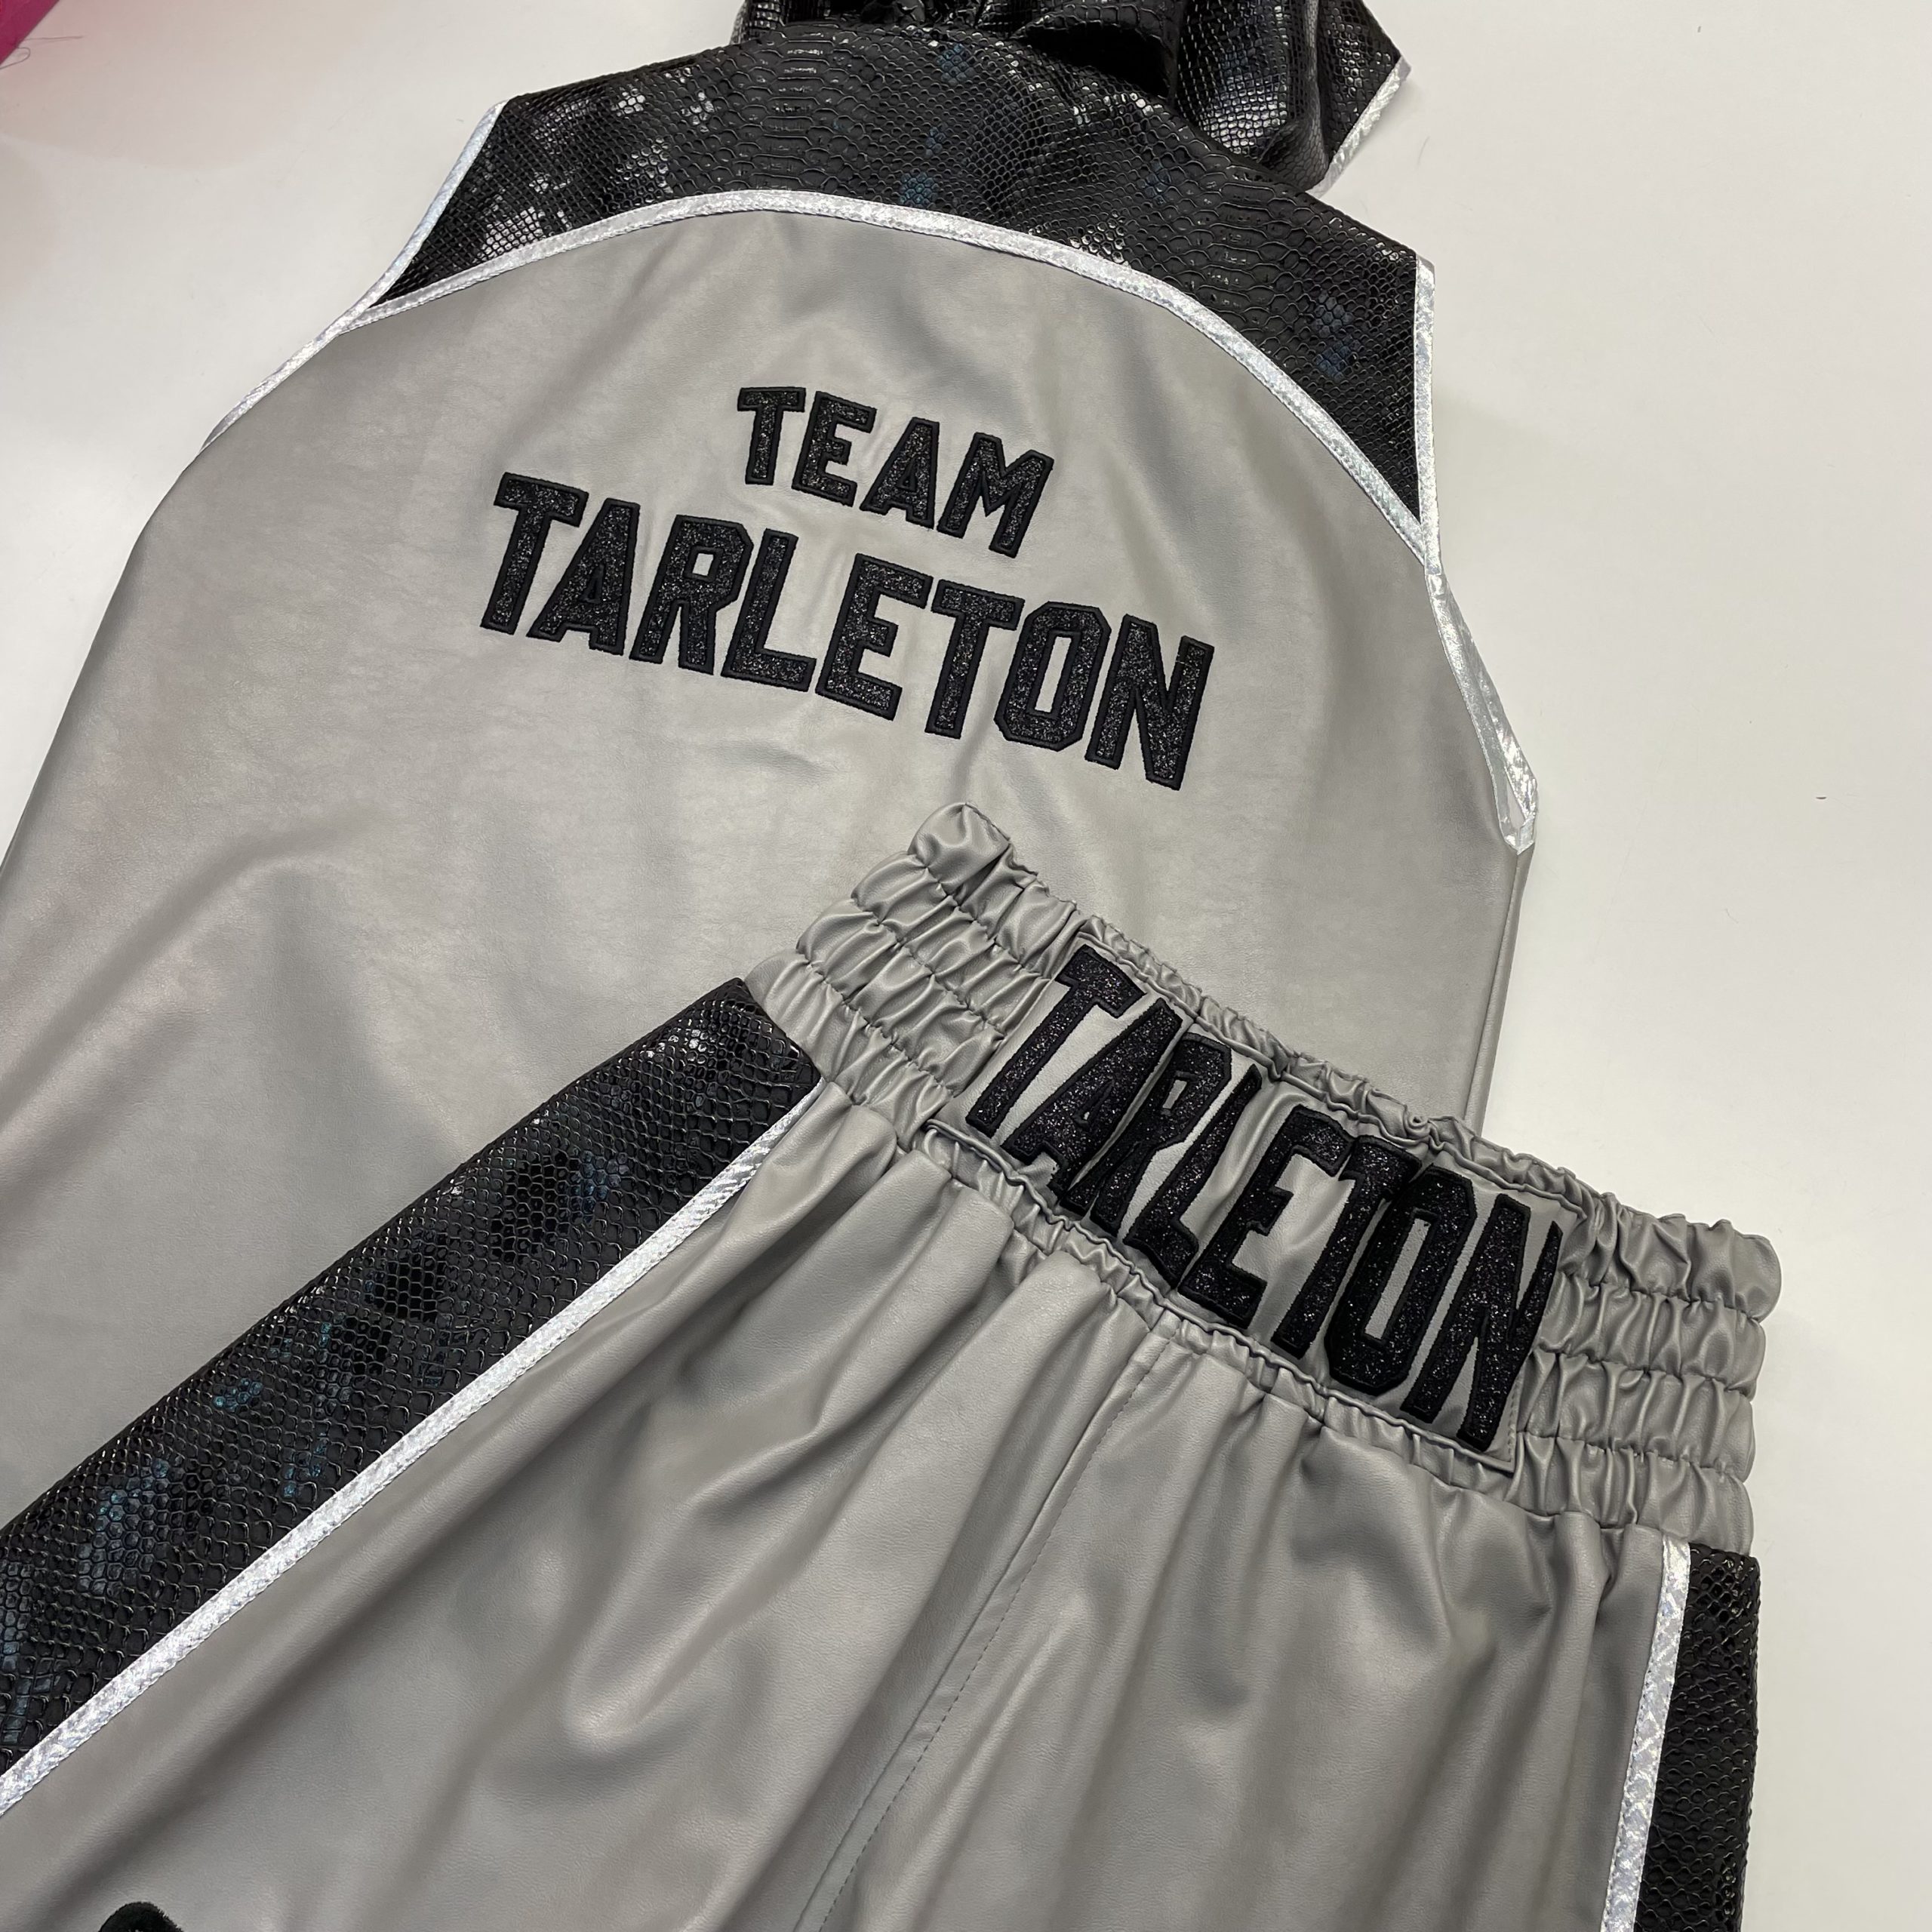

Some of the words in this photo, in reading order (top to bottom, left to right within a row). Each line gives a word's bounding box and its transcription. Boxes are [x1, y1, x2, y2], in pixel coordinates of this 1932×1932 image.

[480, 472, 1215, 790] TARLETON
[737, 386, 1054, 558] TEAM
[966, 944, 1563, 1452] TARLETON
